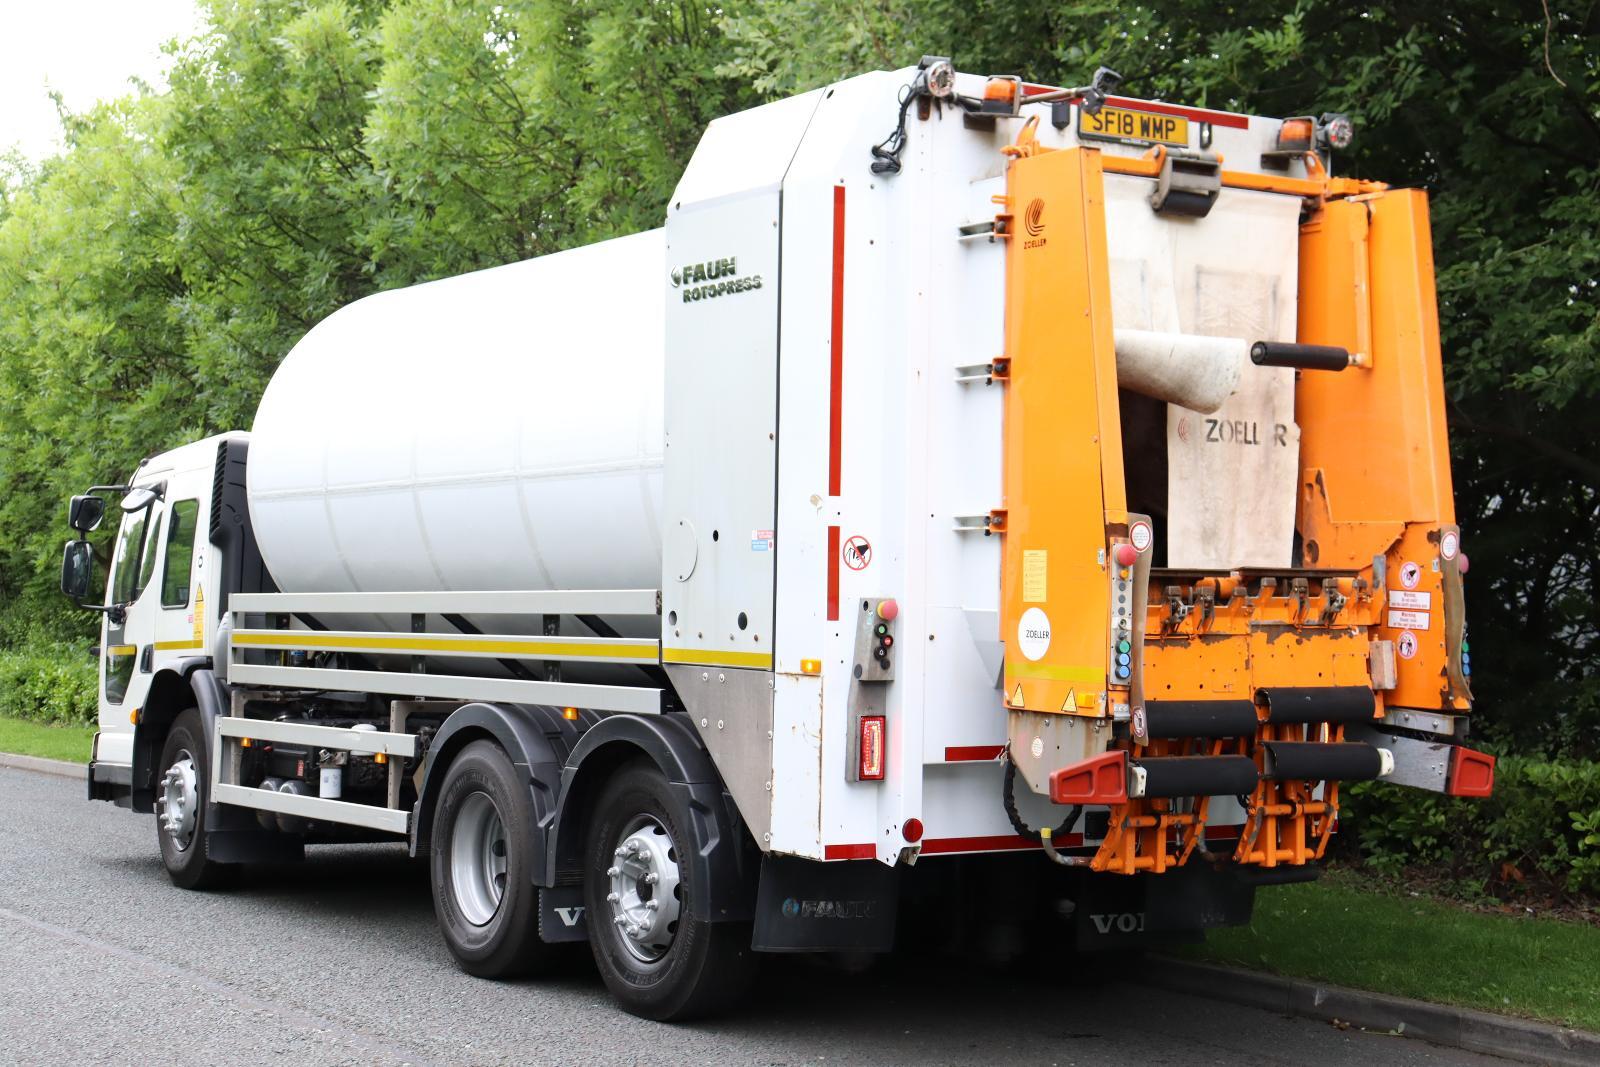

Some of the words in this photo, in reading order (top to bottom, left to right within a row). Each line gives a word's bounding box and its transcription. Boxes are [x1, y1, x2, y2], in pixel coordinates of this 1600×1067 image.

[1092, 110, 1134, 135] SF18
[1139, 116, 1176, 140] WMP
[682, 256, 736, 285] FAUN
[682, 275, 762, 303] ROTOPRESS
[1205, 418, 1288, 448] ZOELLR
[1025, 629, 1050, 640] ZOELLER
